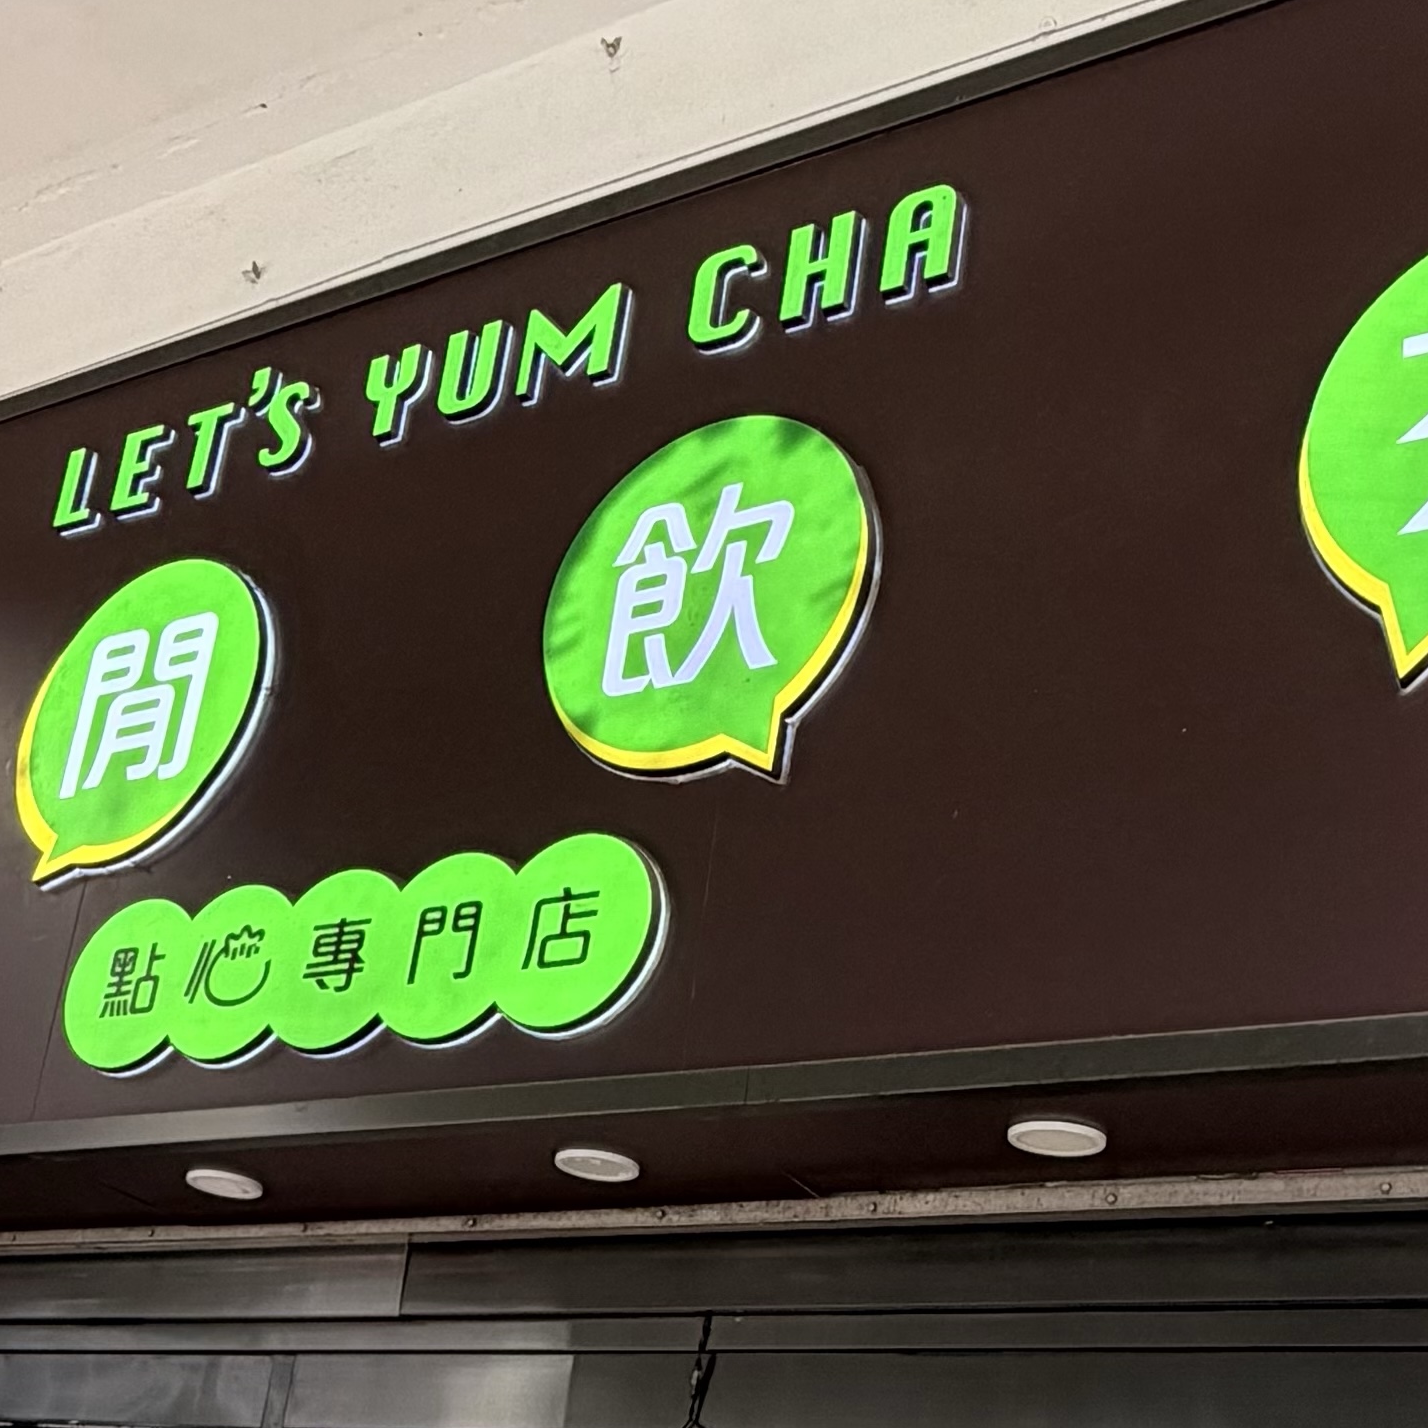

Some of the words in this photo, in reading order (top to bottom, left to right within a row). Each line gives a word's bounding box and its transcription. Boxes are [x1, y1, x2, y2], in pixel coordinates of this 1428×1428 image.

[53, 366, 314, 536] LET'S
[366, 283, 632, 443] YUM
[690, 184, 962, 352] CHA
